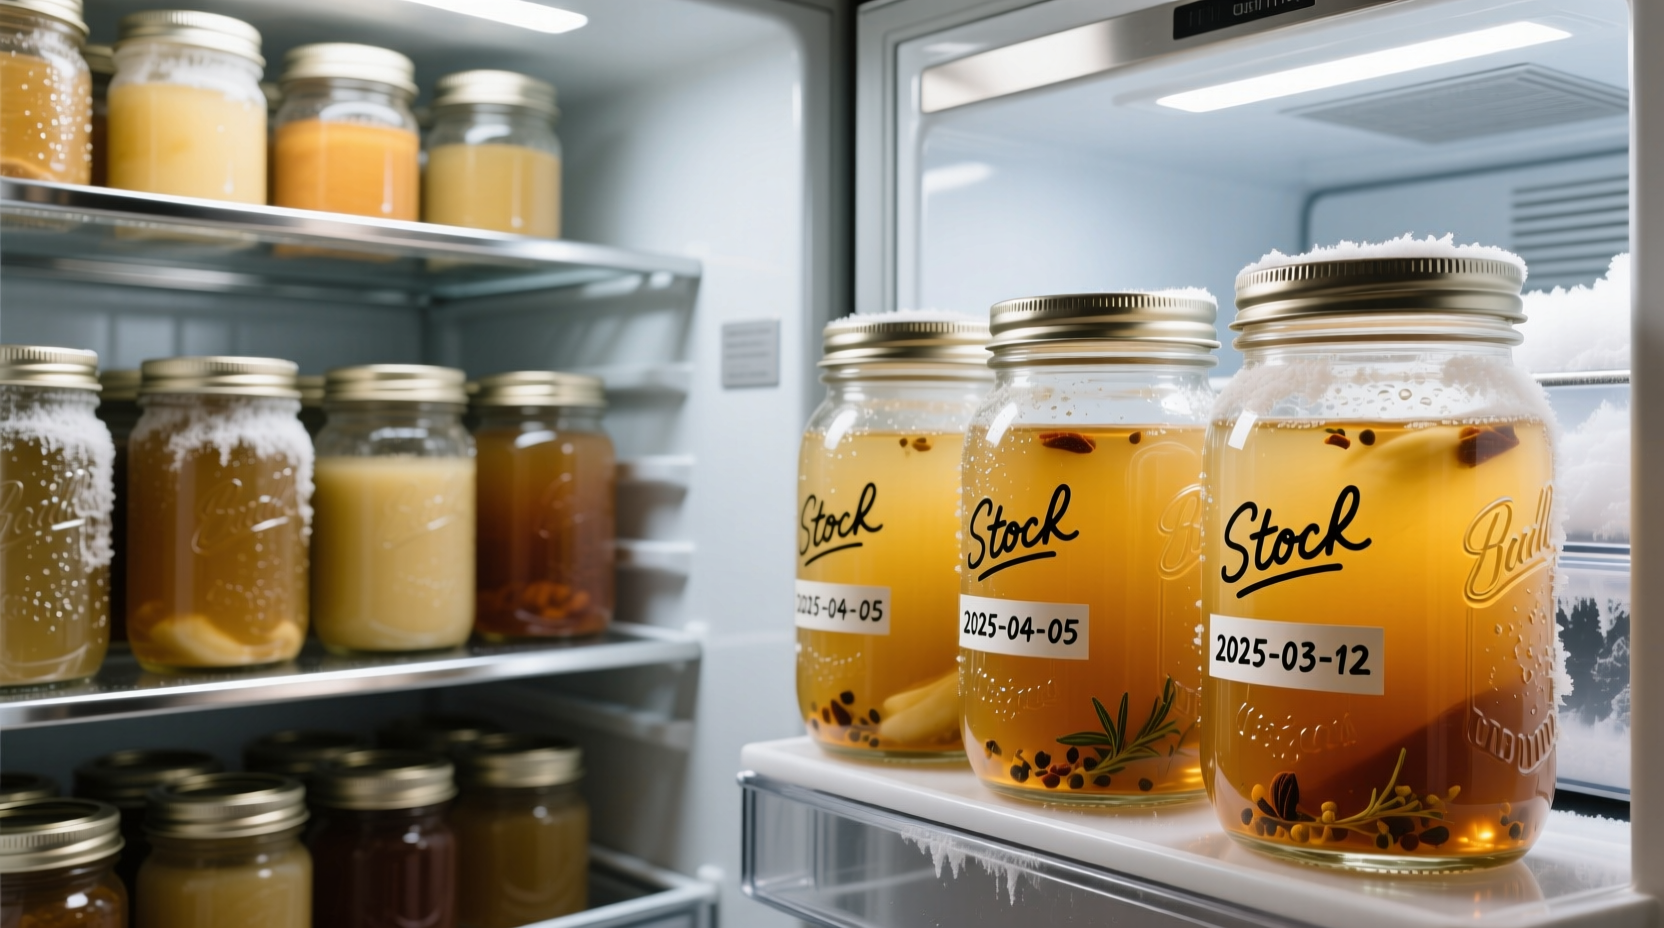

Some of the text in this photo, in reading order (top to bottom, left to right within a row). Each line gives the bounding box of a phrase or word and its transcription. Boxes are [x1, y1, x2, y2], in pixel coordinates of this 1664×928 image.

[800, 482, 883, 556] Stock
[967, 483, 1080, 570] Stock
[1220, 484, 1373, 584] Stock
[963, 610, 1080, 646] 2025-04-05
[1214, 633, 1372, 676] 2025-03-12
